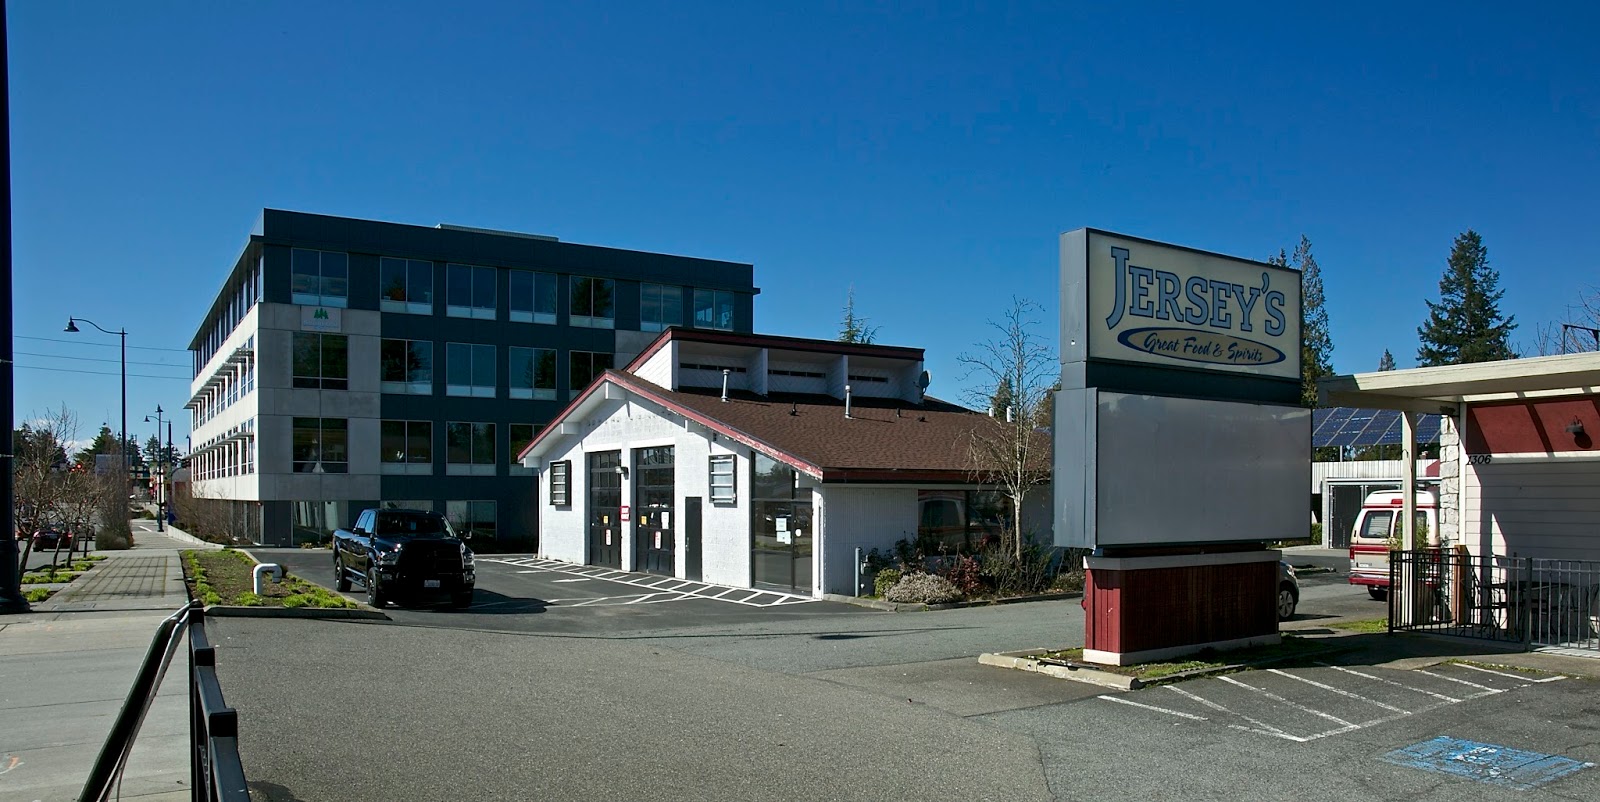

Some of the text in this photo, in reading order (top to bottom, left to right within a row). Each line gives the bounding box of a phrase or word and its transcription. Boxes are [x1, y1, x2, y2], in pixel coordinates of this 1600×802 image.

[1105, 246, 1286, 337] JERSEY'S
[1144, 332, 1264, 363] Great Food & Spirits
[1465, 454, 1492, 465] 1306
